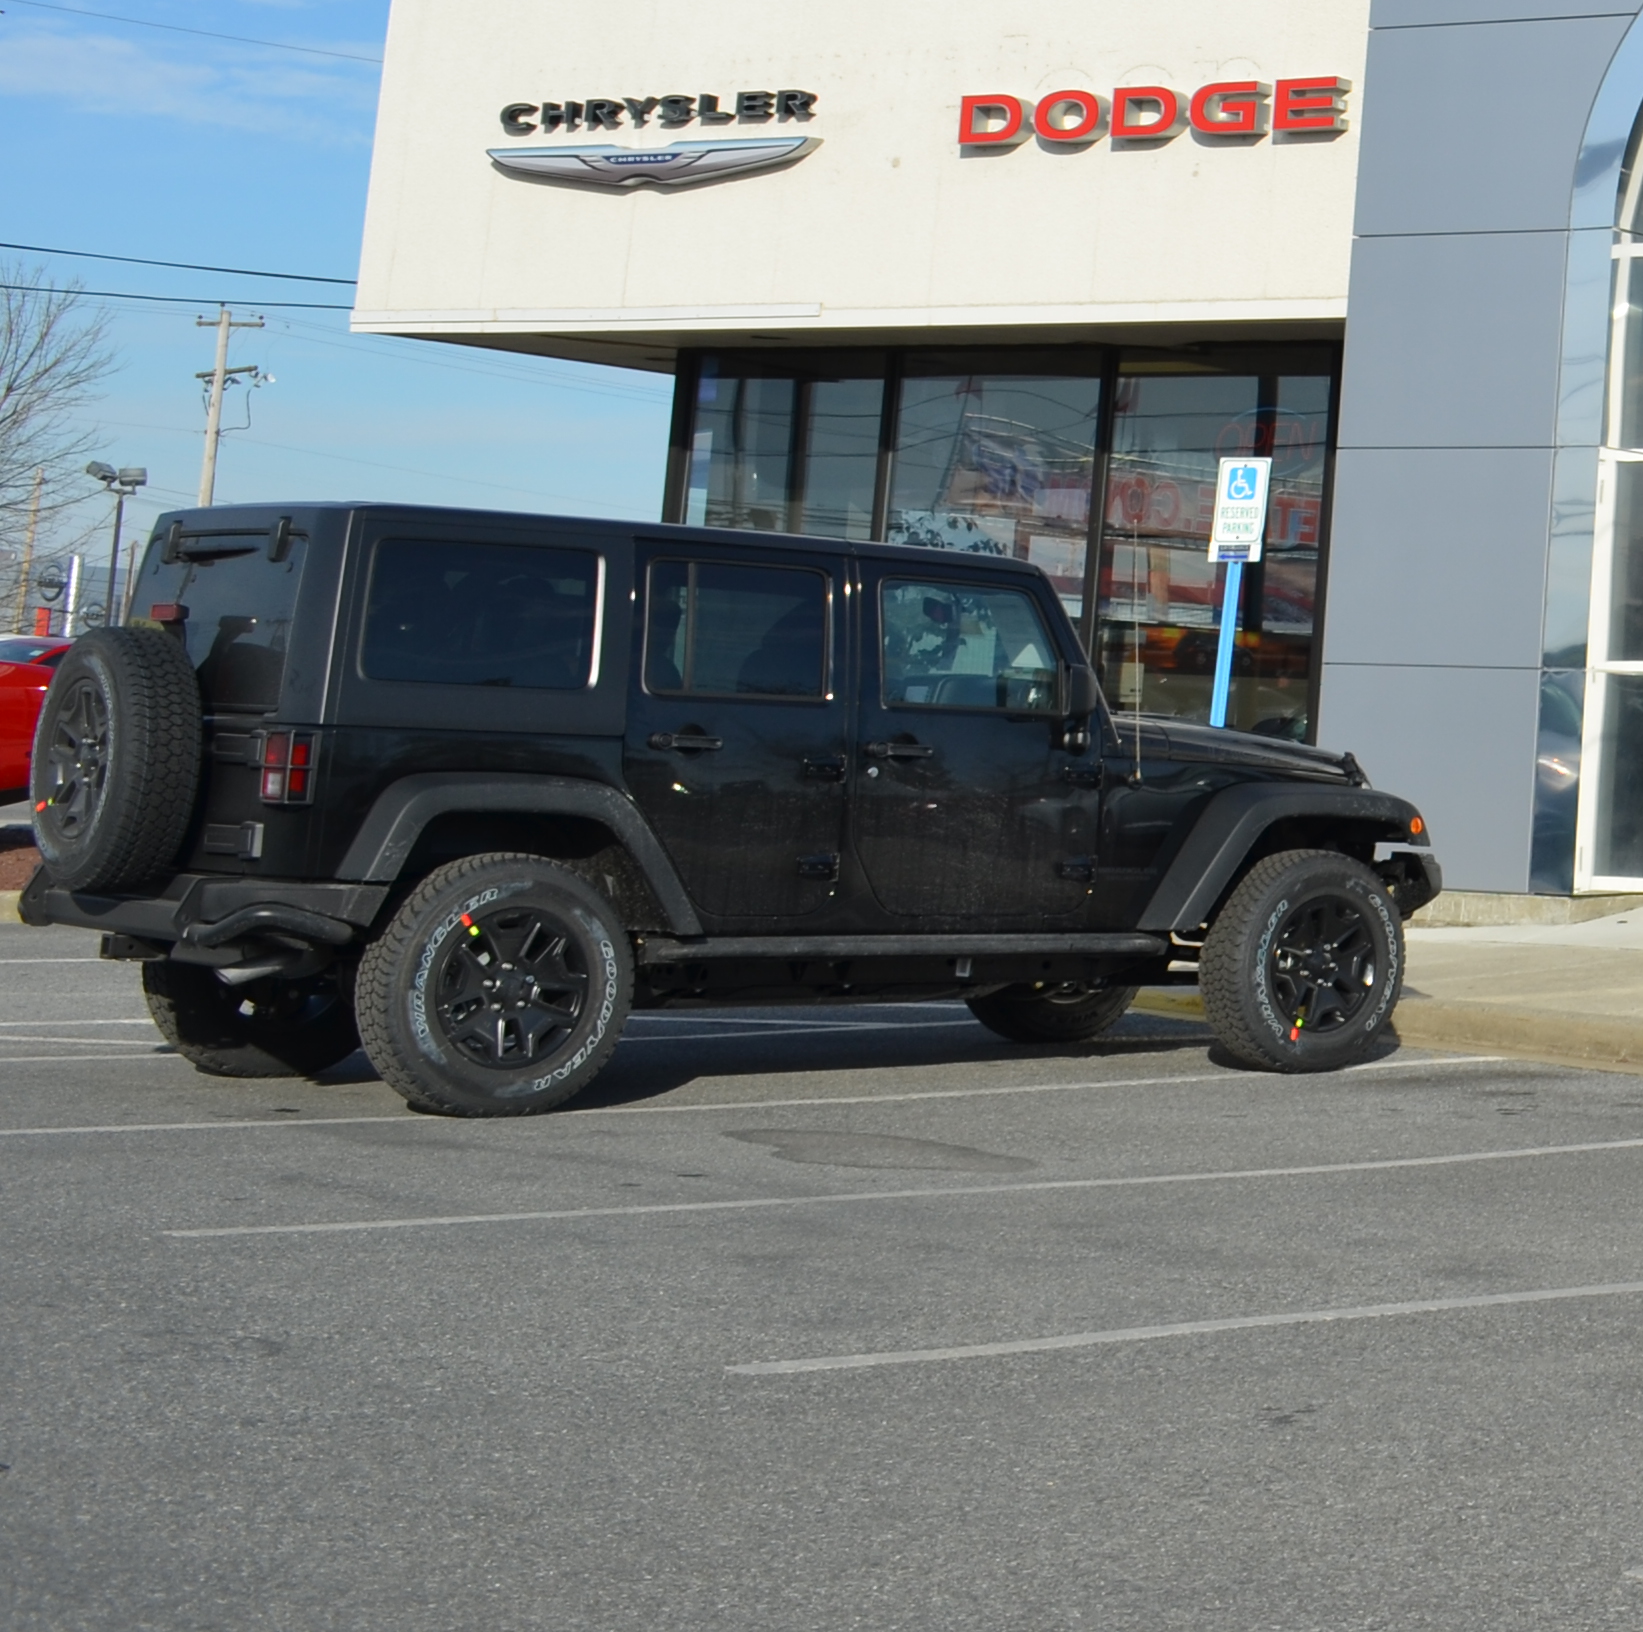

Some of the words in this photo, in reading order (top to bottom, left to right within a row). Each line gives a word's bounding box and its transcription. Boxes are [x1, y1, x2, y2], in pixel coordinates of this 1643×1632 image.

[500, 89, 818, 132] CHRYSLER
[957, 75, 1344, 146] DODGE
[609, 155, 673, 163] CHRYSLER
[1215, 421, 1319, 463] OPEN
[1220, 506, 1259, 519] RESERVED
[1222, 522, 1255, 534] PARKING
[412, 887, 499, 1039] WRANGLER
[1256, 899, 1289, 1037] WRANGLER
[1364, 893, 1398, 1032] GOODYEAR
[532, 938, 618, 1092] GOODYEAR
